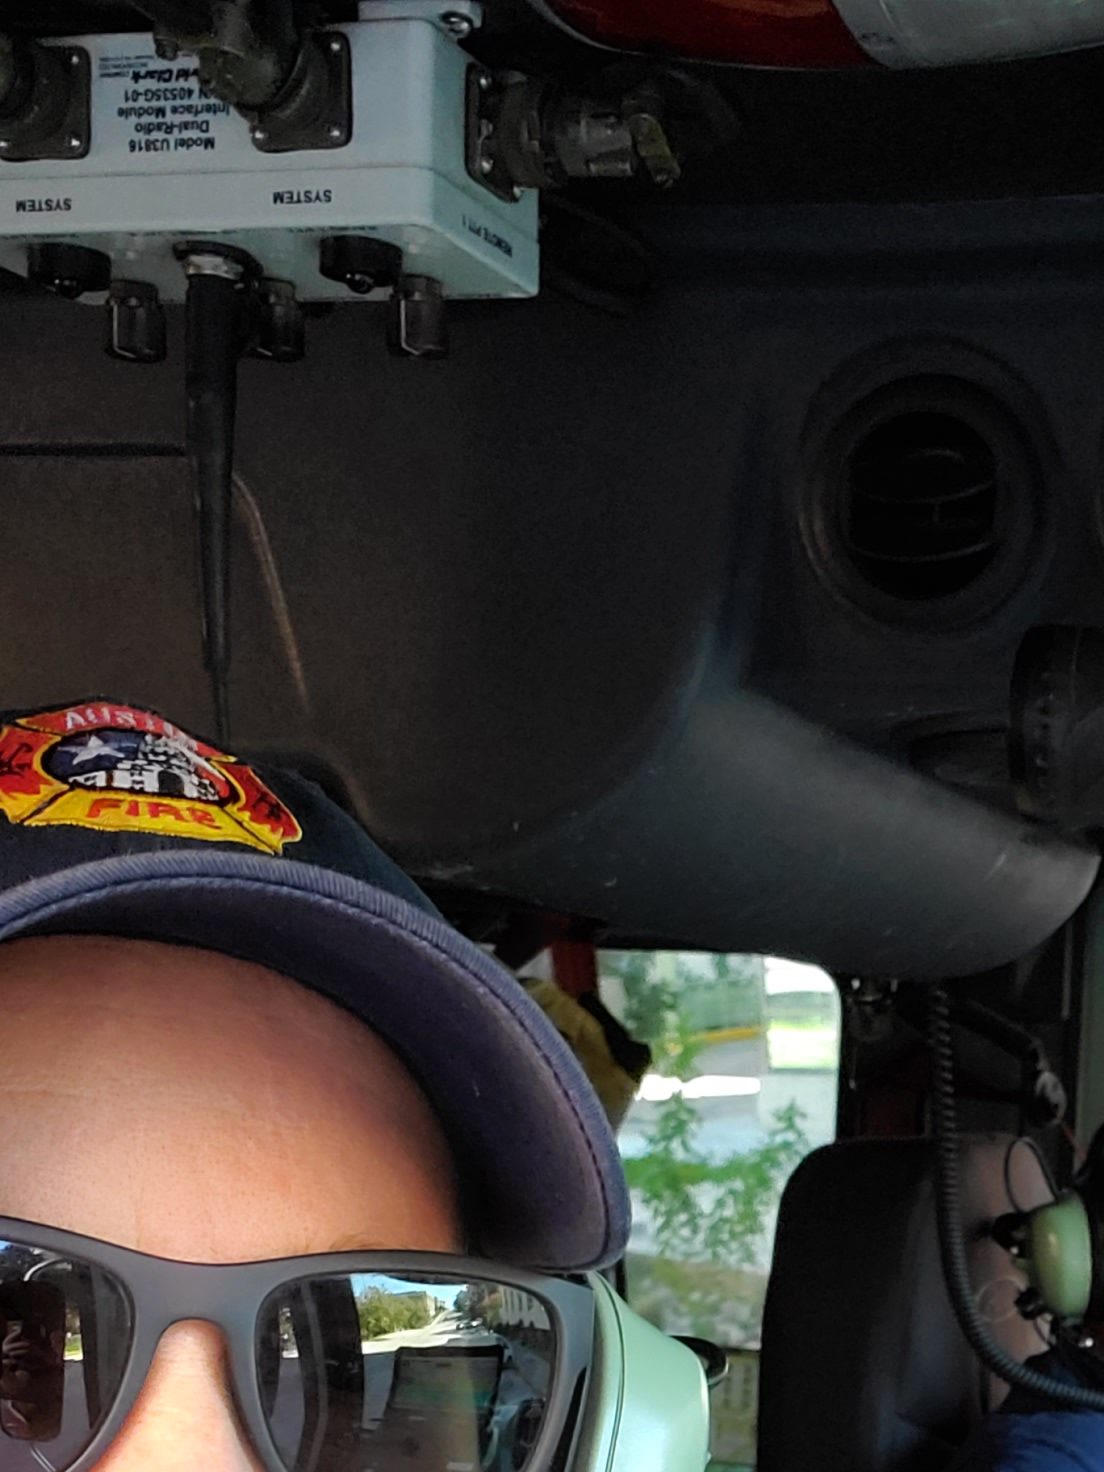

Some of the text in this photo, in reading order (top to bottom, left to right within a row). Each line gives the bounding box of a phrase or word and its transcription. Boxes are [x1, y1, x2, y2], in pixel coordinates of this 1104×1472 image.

[131, 68, 172, 83] Clark
[124, 88, 195, 100] 40535G-01
[117, 103, 230, 118] Interface Module
[134, 119, 210, 134] Dual-Radio
[128, 137, 215, 152] Model U3816
[15, 197, 72, 213] SYSTEM
[272, 189, 332, 206] SYSTEM
[86, 797, 222, 829] FIRE
